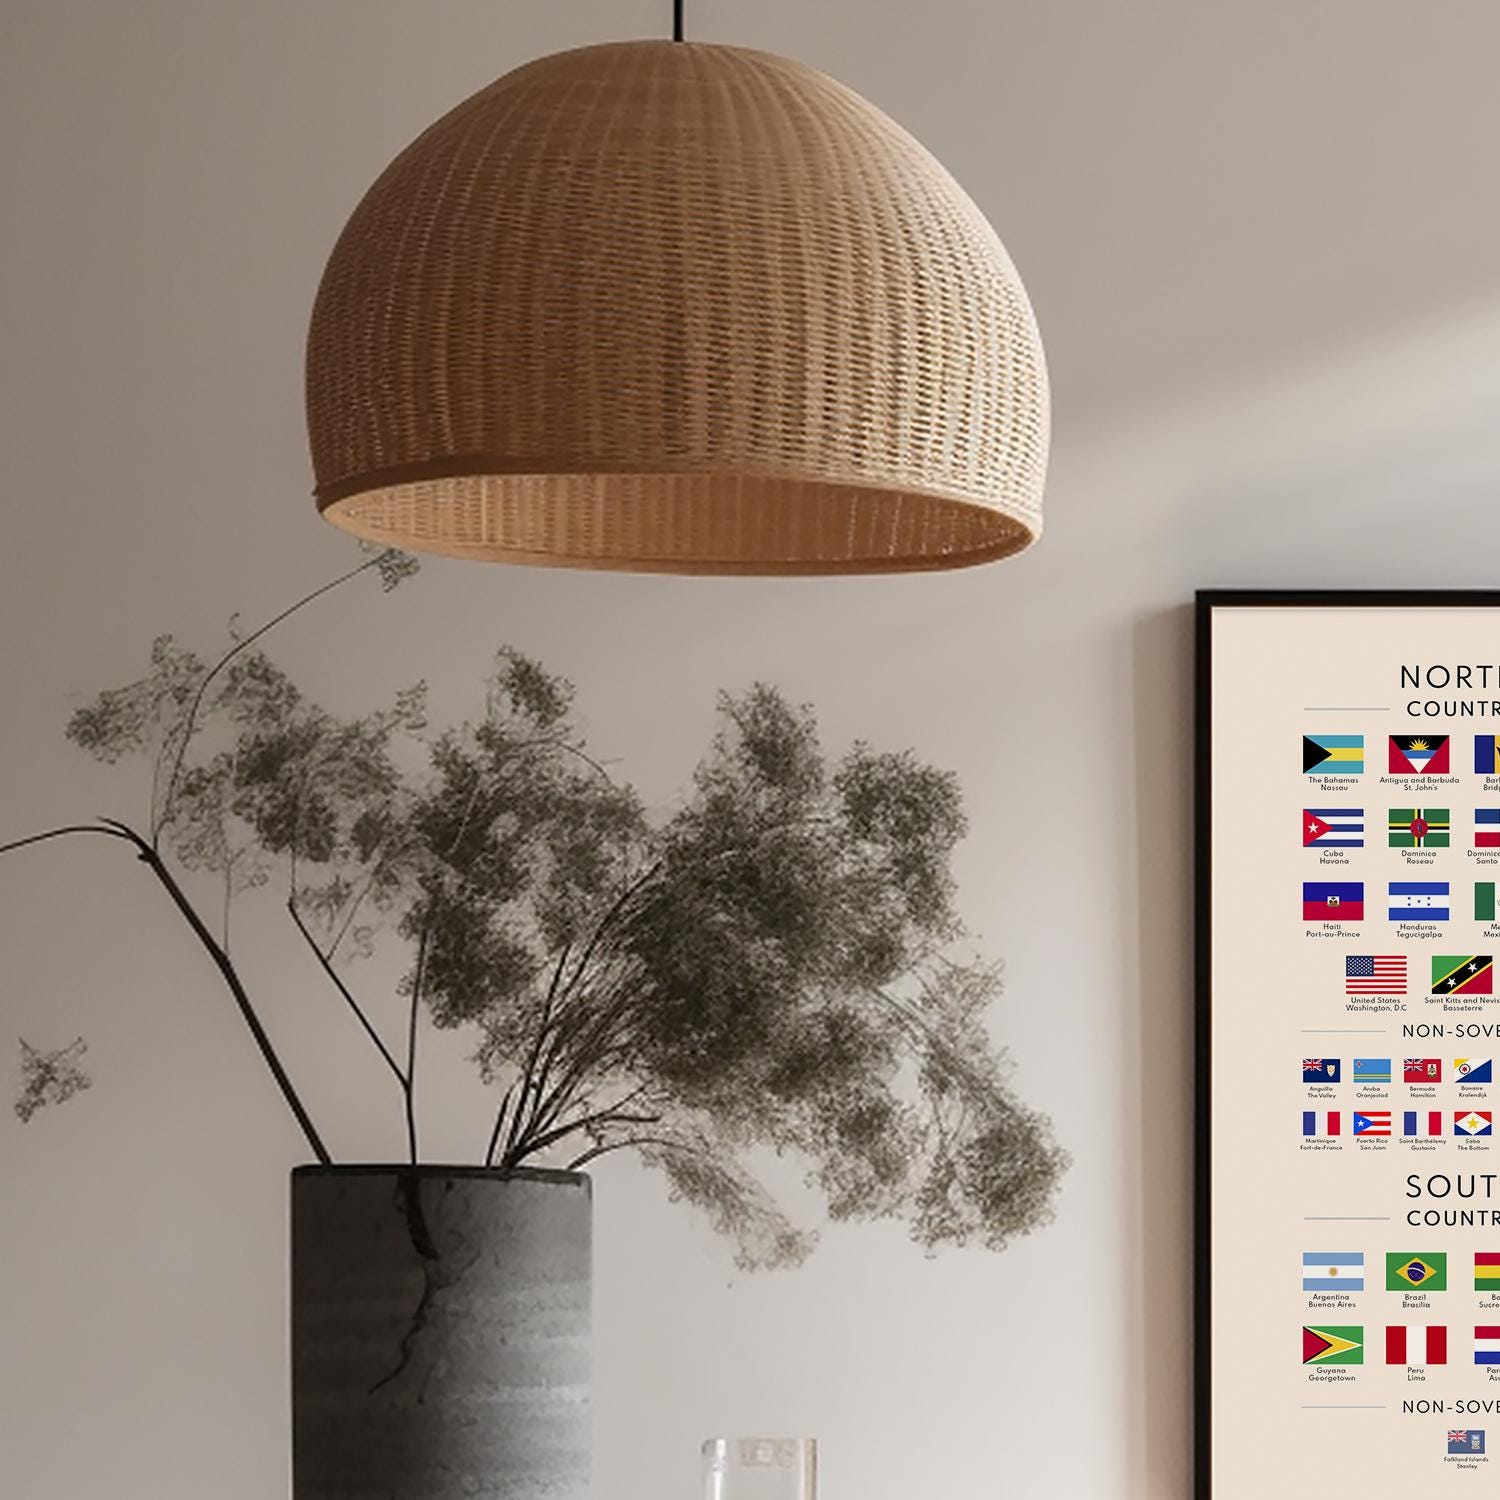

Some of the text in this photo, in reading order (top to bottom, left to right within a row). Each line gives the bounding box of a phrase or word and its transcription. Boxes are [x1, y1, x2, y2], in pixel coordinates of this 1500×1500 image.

[1379, 777, 1409, 786] Antigua
[1323, 923, 1341, 931] Haiti
[1400, 923, 1437, 931] Honduras
[1396, 931, 1443, 940] Tegucigalpa
[1312, 1294, 1350, 1302] Argentina
[1316, 1367, 1346, 1375] Guyana
[1308, 1375, 1356, 1383] Georgetown
